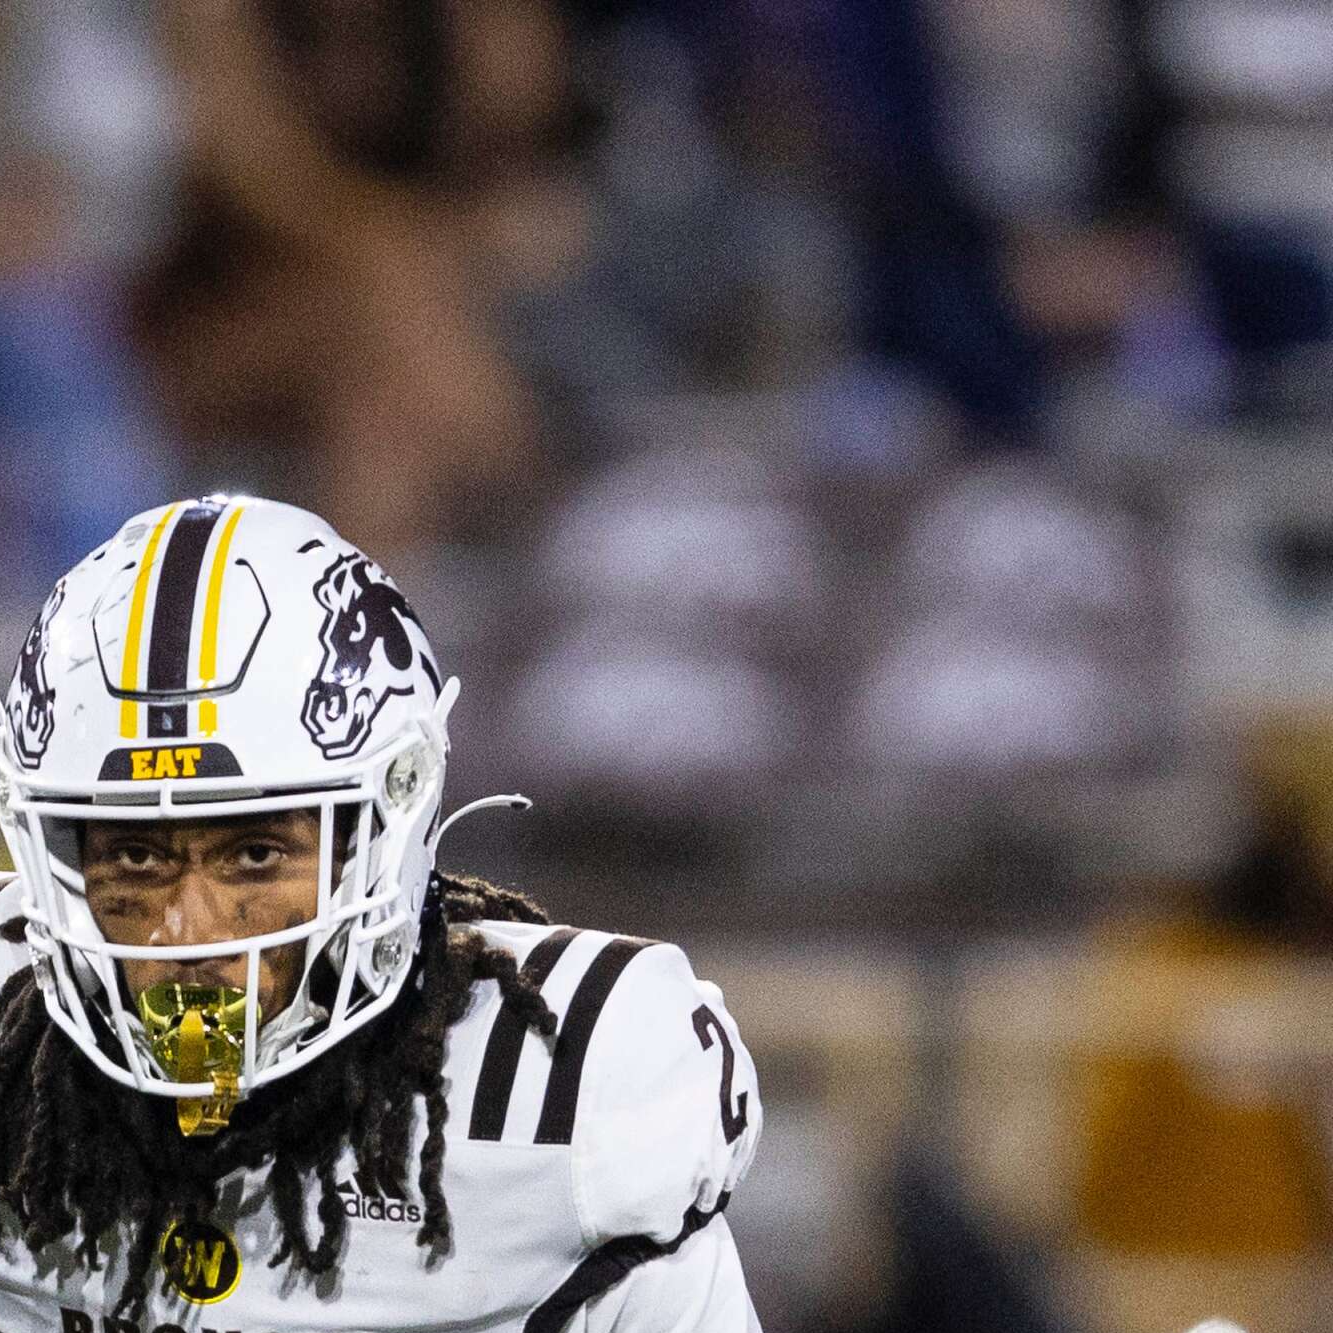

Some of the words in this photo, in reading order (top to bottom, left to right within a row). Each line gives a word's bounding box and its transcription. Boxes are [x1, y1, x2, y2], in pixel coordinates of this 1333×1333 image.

[130, 747, 201, 779] EAT
[691, 1003, 749, 1146] 2
[342, 1194, 421, 1223] didas
